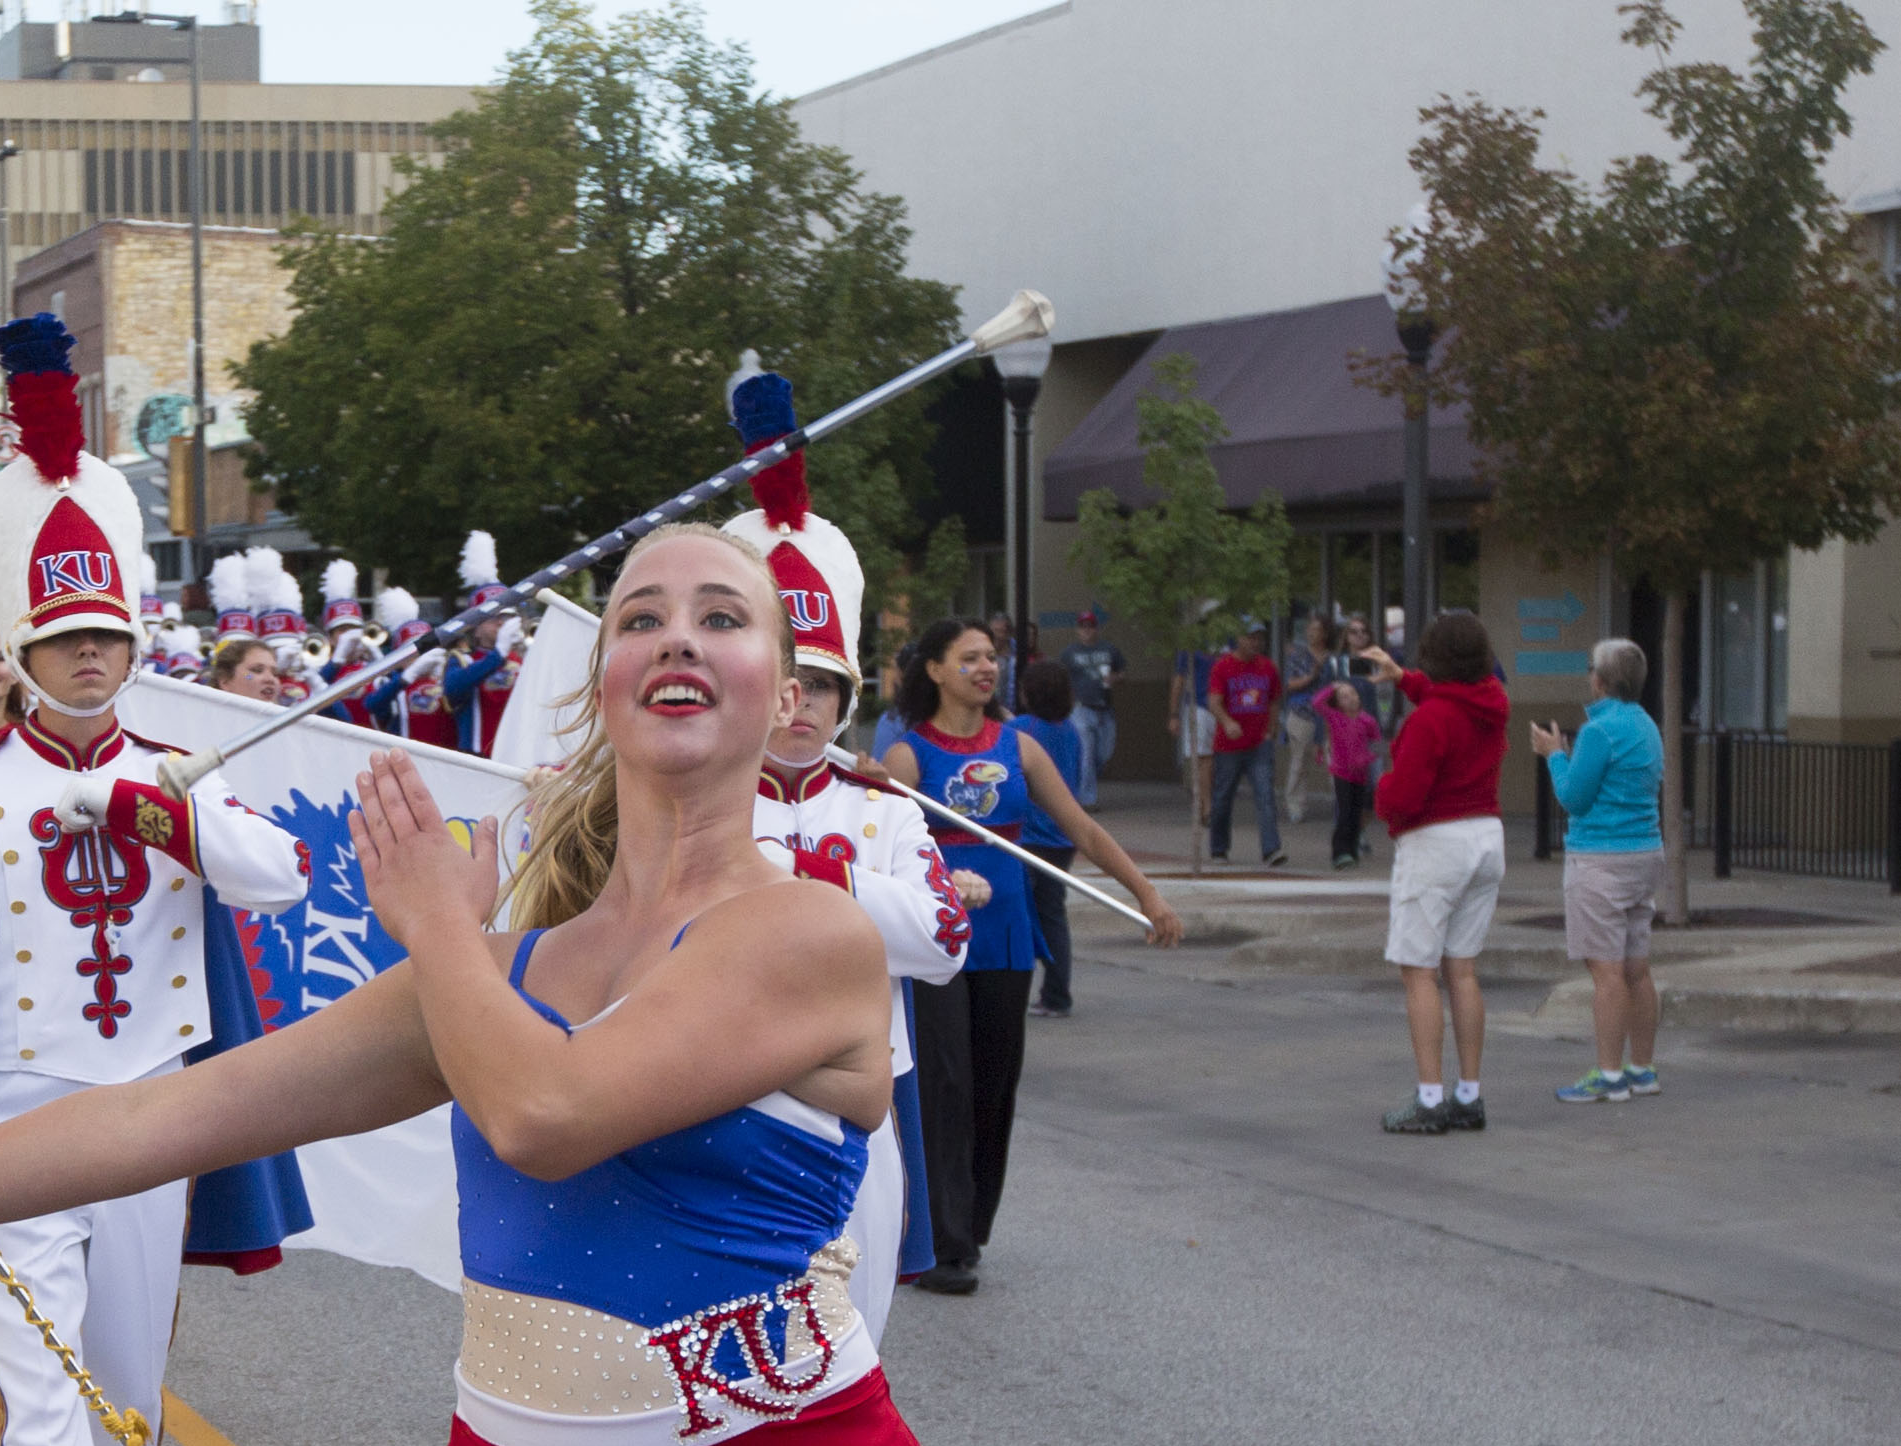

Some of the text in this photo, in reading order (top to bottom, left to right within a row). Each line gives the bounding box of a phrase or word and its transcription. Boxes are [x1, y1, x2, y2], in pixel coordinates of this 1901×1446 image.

[37, 551, 111, 597] KU
[964, 788, 980, 800] KU
[636, 1277, 838, 1445] KU
